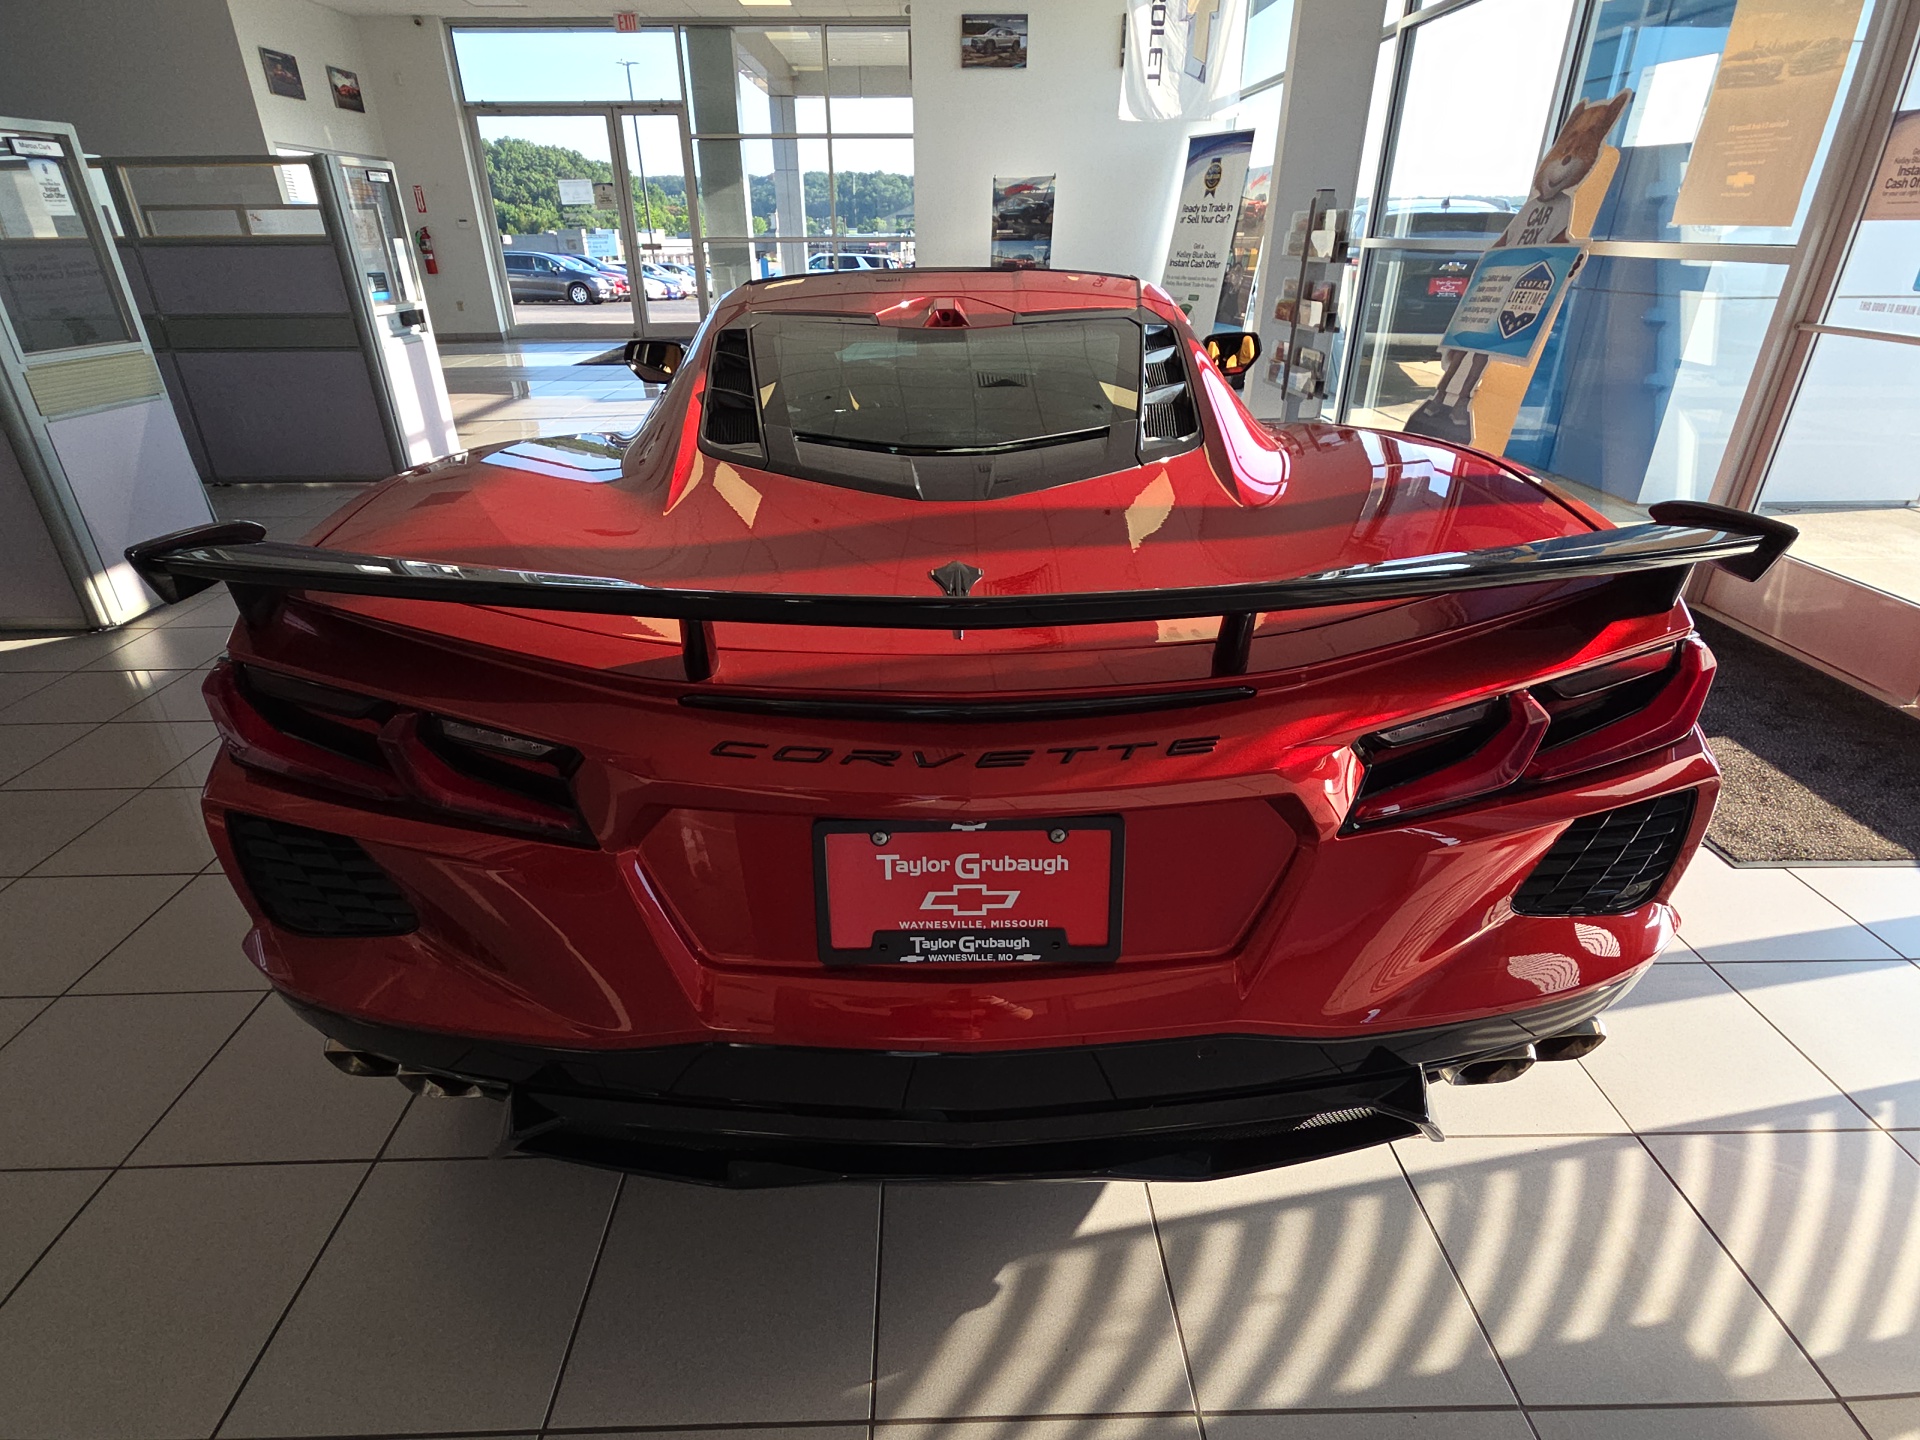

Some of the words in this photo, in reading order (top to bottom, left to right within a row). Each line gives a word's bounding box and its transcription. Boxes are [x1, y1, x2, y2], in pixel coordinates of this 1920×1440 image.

[617, 14, 636, 31] EXIT
[1147, 0, 1166, 86] OLET
[1885, 178, 1908, 189] Cash
[1910, 177, 1920, 188] Of
[1201, 204, 1207, 212] to
[1209, 203, 1226, 212] Trade
[1227, 202, 1233, 212] In
[1187, 215, 1199, 223] Sell
[1201, 215, 1214, 223] Your
[1215, 214, 1231, 223] Car?
[1527, 206, 1553, 227] CAR
[1517, 227, 1544, 246] FOX
[1191, 259, 1204, 267] Cash
[1205, 260, 1221, 268] Offer
[1508, 291, 1547, 305] LIFETIME
[709, 735, 1221, 768] CORVETTE
[876, 855, 950, 880] Taylor
[954, 853, 1069, 879] Grubaugh
[899, 920, 987, 929] WAYNESVILLE,
[990, 919, 1048, 928] MISSOURI
[909, 936, 956, 953] Taylor
[958, 936, 1030, 952] Grubaugh
[928, 954, 996, 962] WAYNESVILLE,
